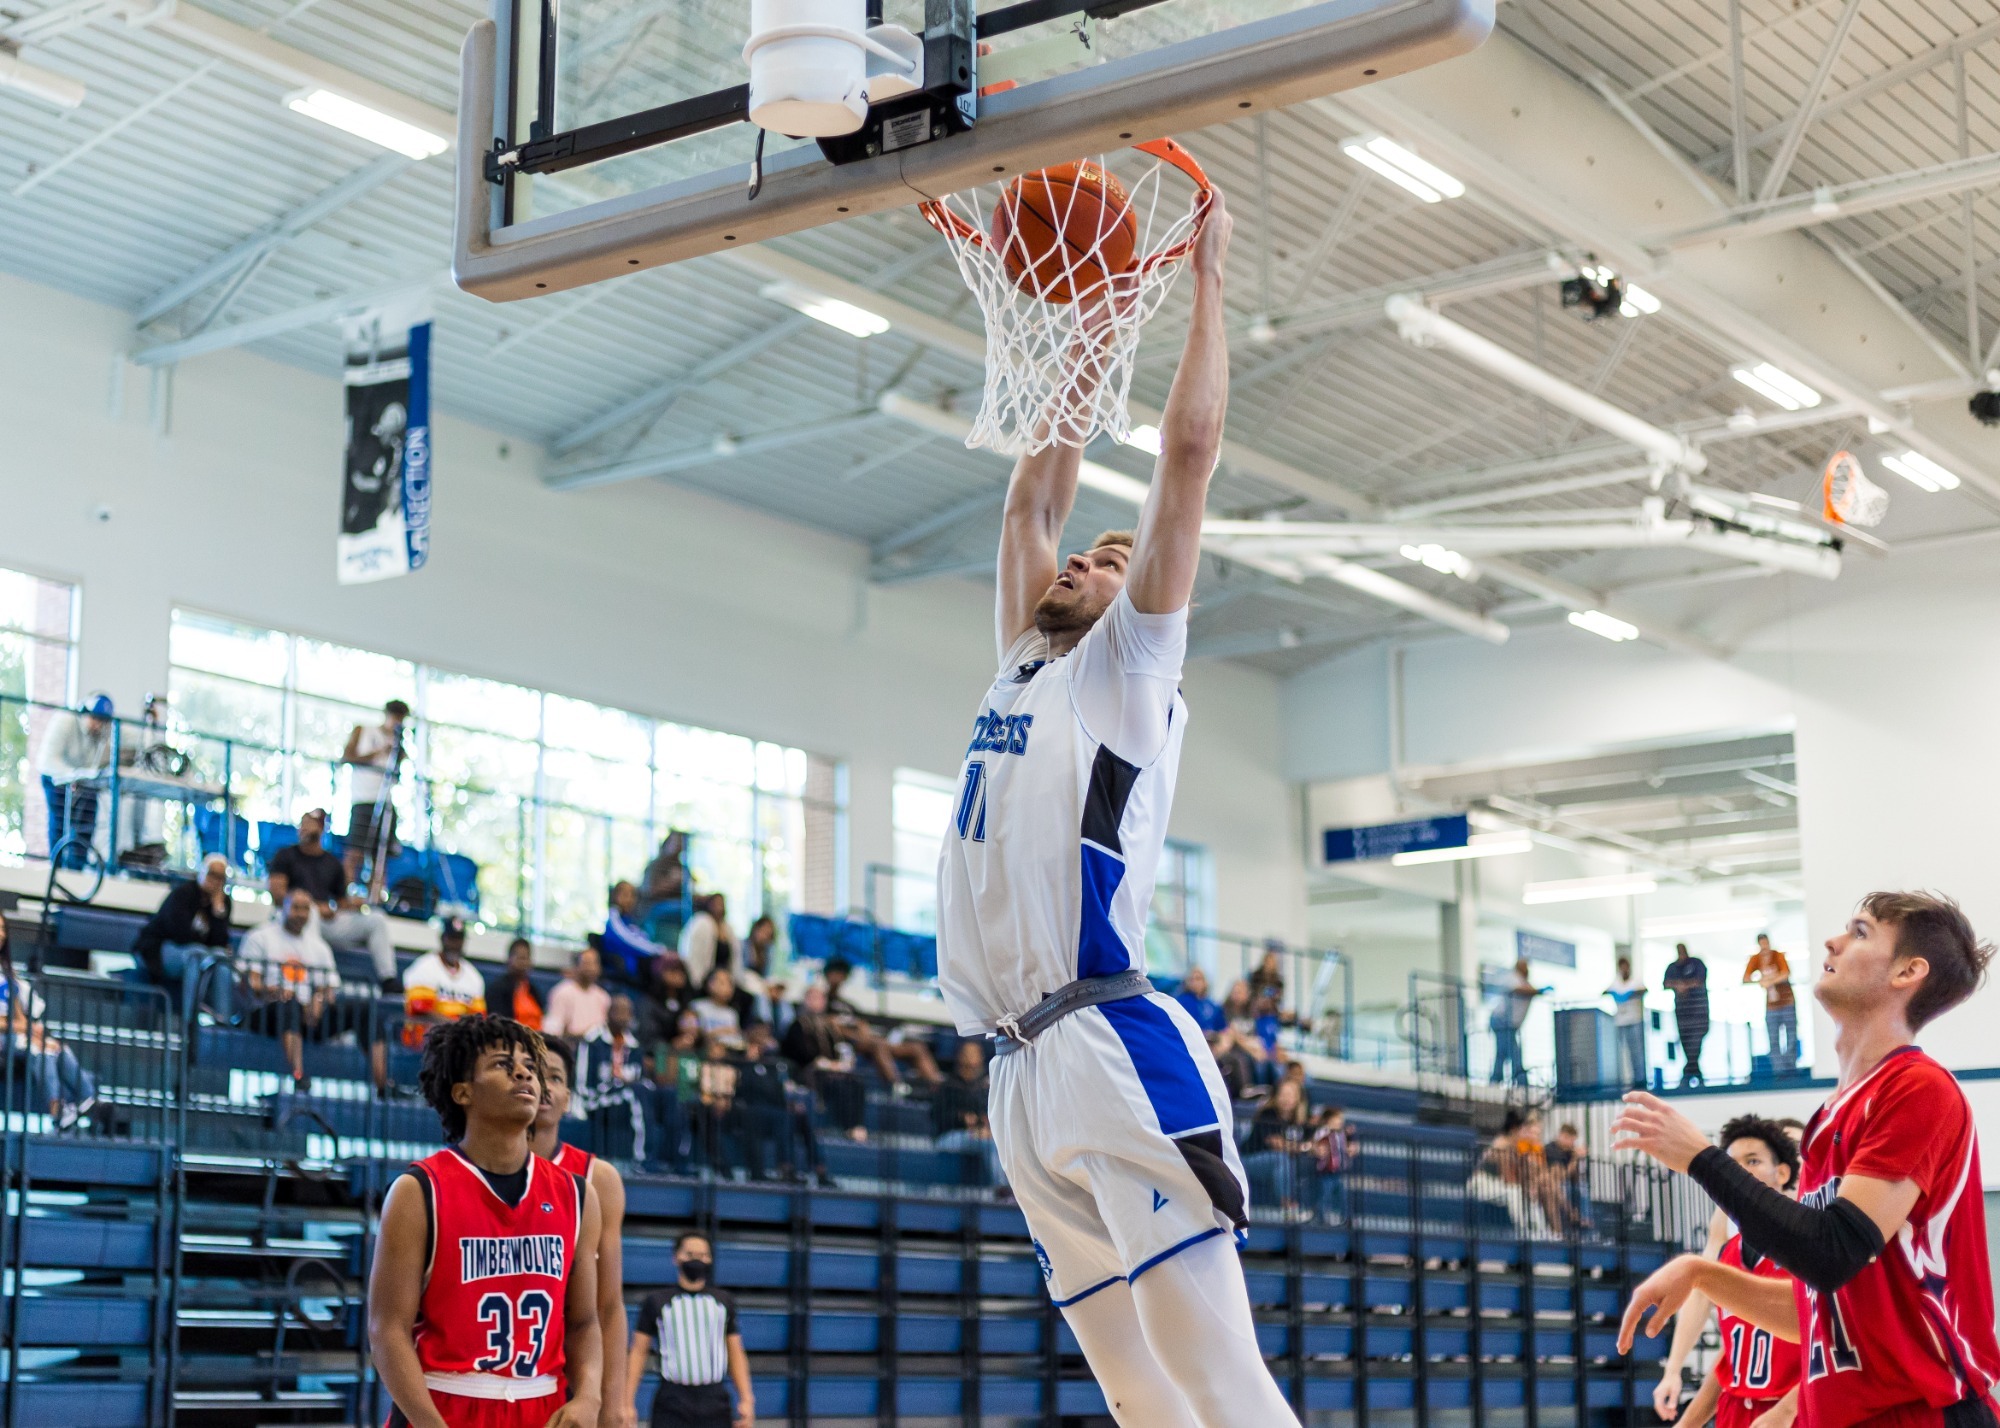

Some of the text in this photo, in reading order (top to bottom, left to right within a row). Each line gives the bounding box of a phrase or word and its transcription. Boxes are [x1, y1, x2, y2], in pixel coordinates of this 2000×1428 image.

[459, 1235, 564, 1284] TIMBERWOLVES
[473, 1289, 553, 1378] 33
[1730, 1322, 1774, 1389] 10
